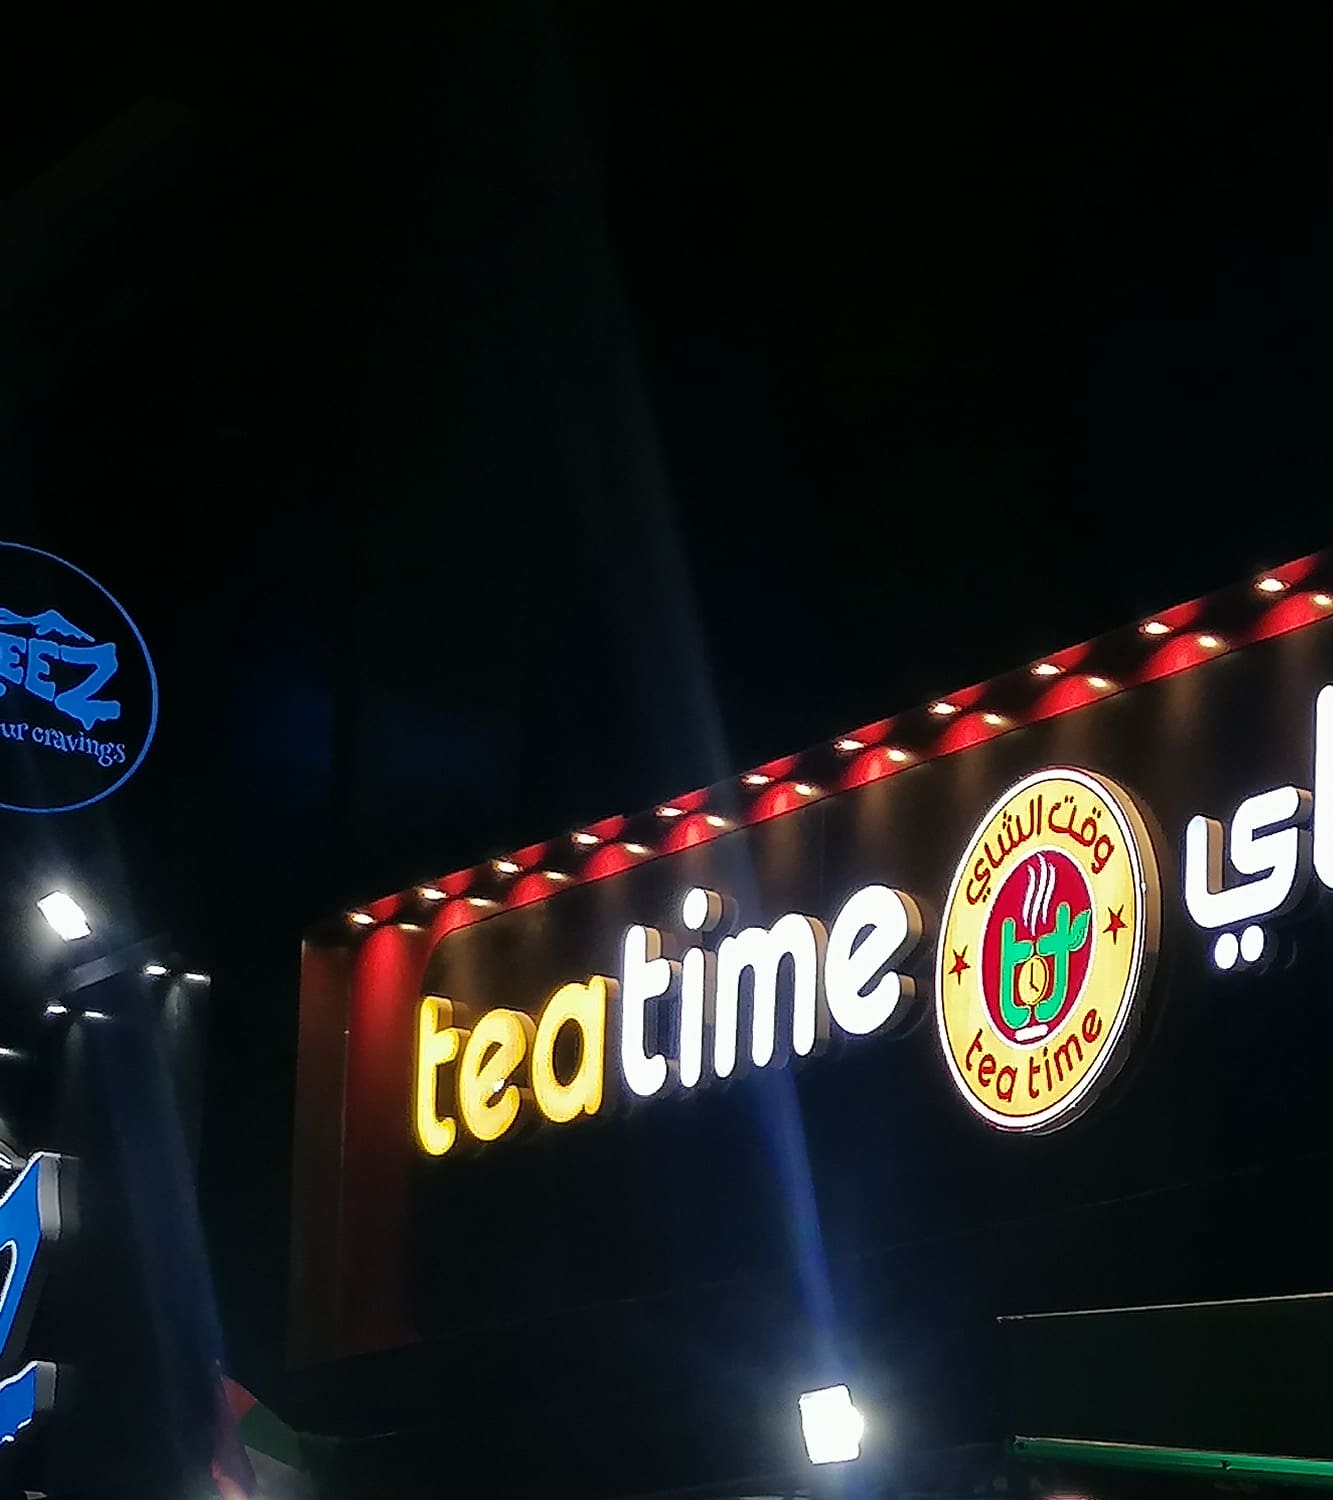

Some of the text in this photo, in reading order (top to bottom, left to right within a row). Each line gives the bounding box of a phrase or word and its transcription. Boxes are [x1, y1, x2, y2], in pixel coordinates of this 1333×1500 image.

[0, 632, 121, 731] EEZ
[32, 726, 126, 767] cravings
[965, 794, 1116, 906] وقت الشاي
[966, 1008, 1103, 1102] tea time
